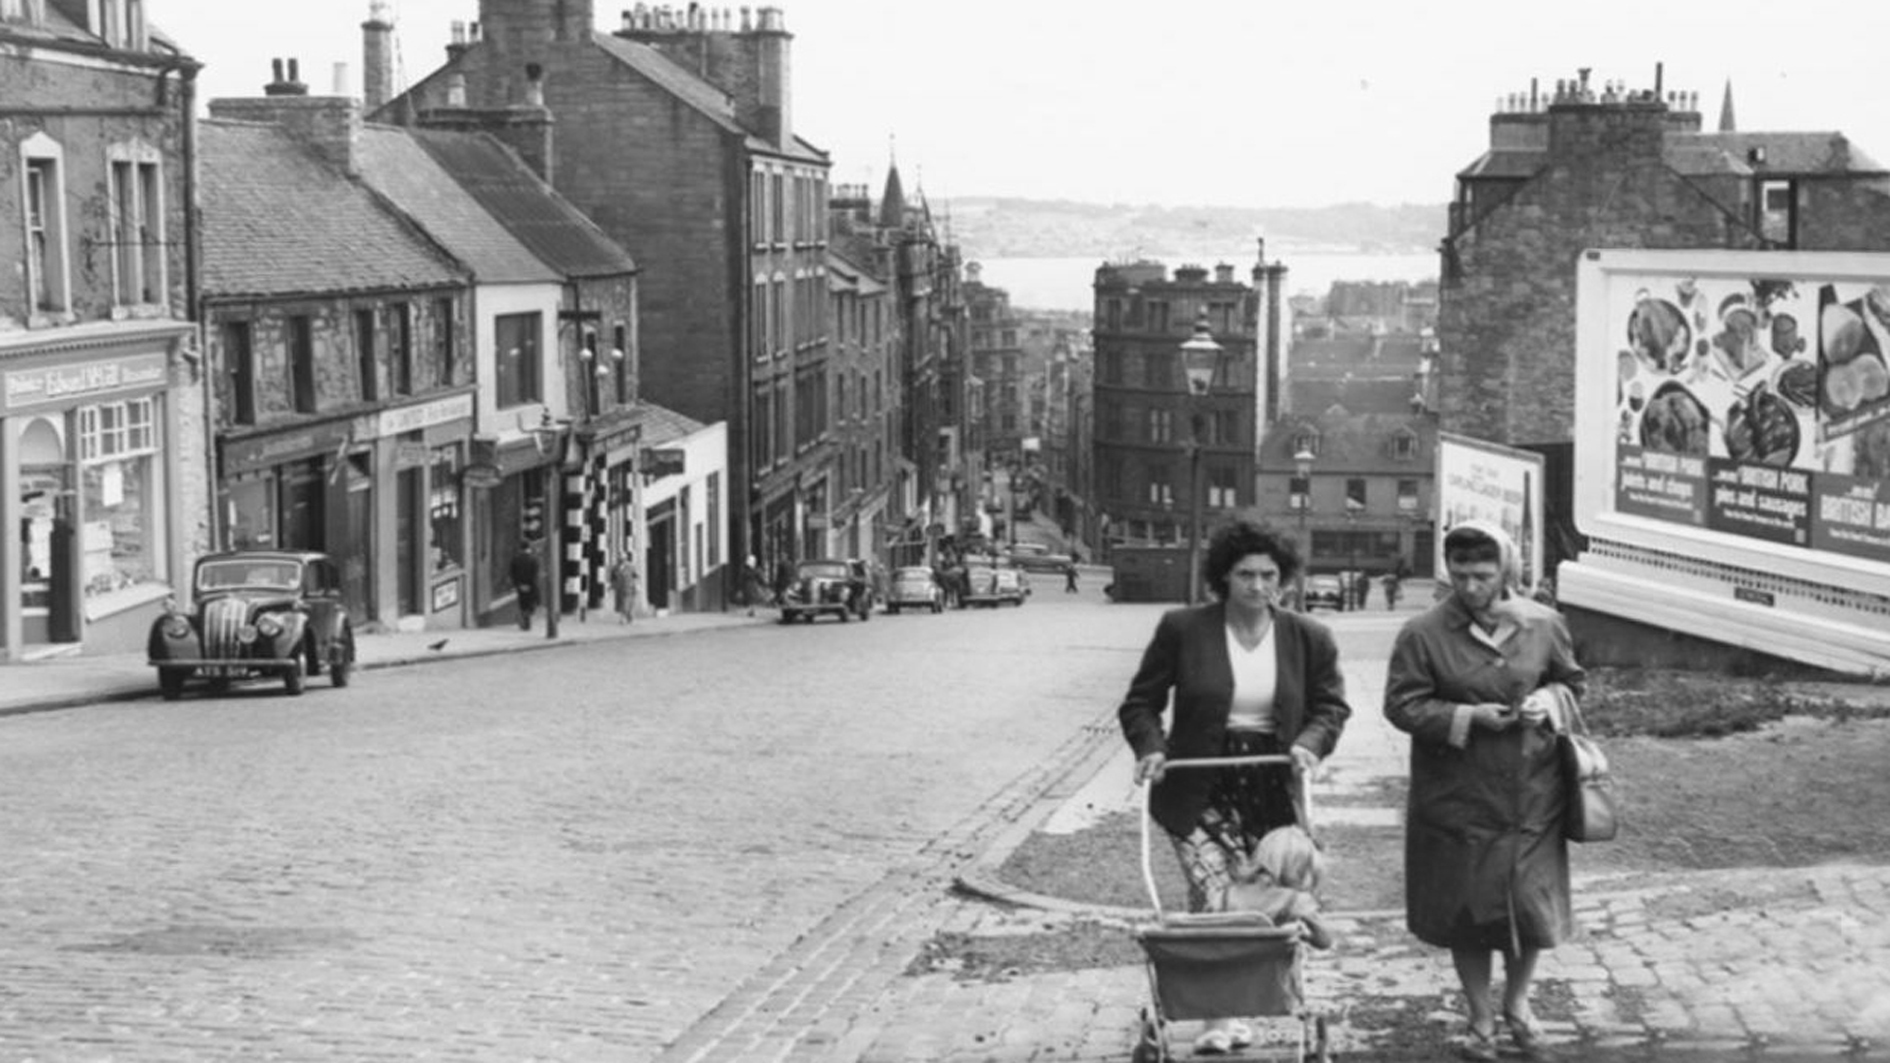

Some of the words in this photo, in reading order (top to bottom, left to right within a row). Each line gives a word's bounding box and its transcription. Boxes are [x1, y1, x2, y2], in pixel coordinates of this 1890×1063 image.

[1647, 474, 1664, 492] and
[1740, 466, 1779, 490] BRITISH
[1780, 472, 1809, 495] PORK
[1715, 485, 1736, 507] pies
[1738, 488, 1757, 508] and
[1758, 495, 1807, 520] sausages
[1820, 494, 1873, 527] BRITISH
